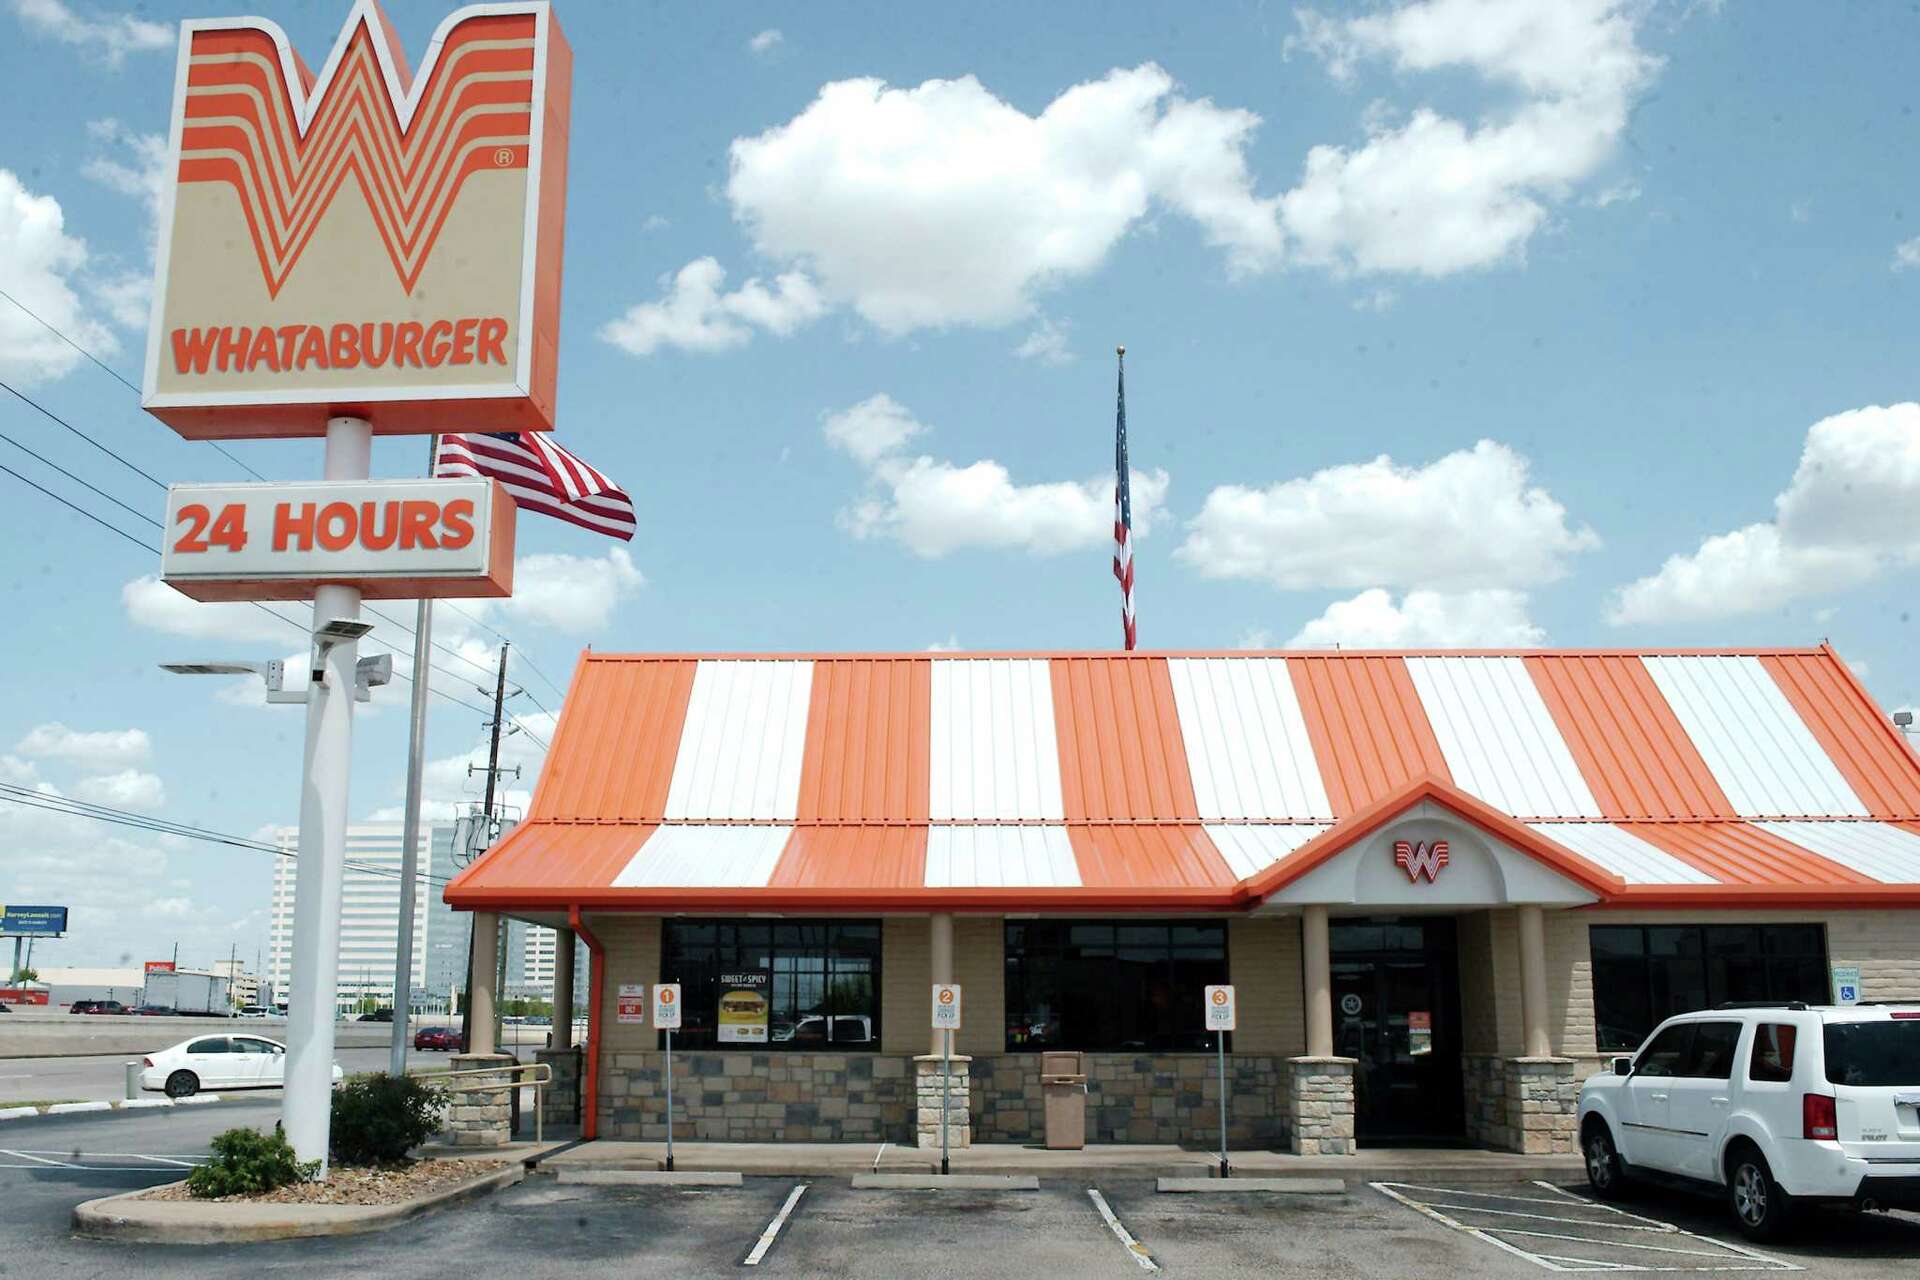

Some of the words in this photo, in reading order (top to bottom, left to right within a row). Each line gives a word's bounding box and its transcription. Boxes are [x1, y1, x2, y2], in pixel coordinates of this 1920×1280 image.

[171, 317, 508, 375] WHATABURGER
[173, 503, 248, 553] 24
[271, 499, 475, 553] HOURS
[748, 975, 767, 983] SPICY
[942, 991, 951, 1002] 2
[1216, 992, 1225, 1004] 3
